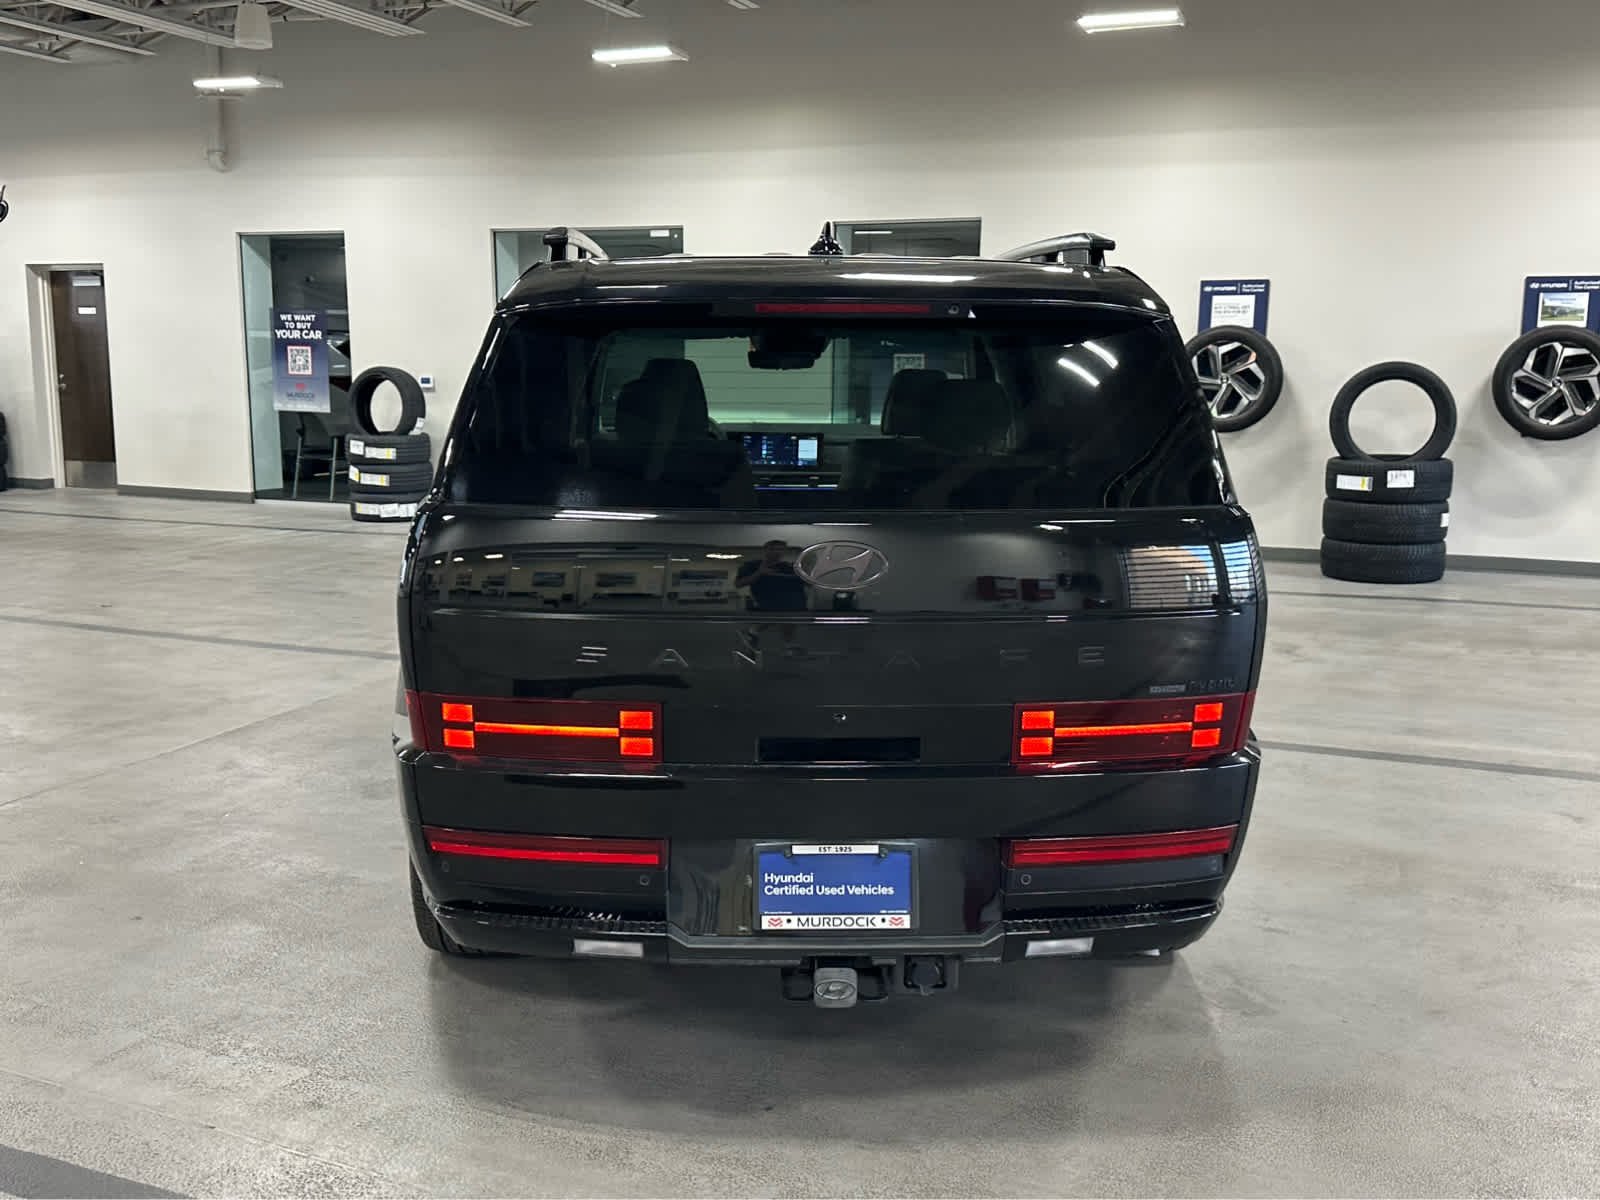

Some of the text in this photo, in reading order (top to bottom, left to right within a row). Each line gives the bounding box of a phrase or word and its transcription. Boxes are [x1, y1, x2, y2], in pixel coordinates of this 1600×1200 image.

[296, 322, 312, 330] BUY
[275, 329, 322, 340] YOUR CAR
[764, 872, 814, 885] Hyundai
[764, 884, 895, 895] Certified Used Vehicles
[797, 916, 877, 928] MURDOCK
